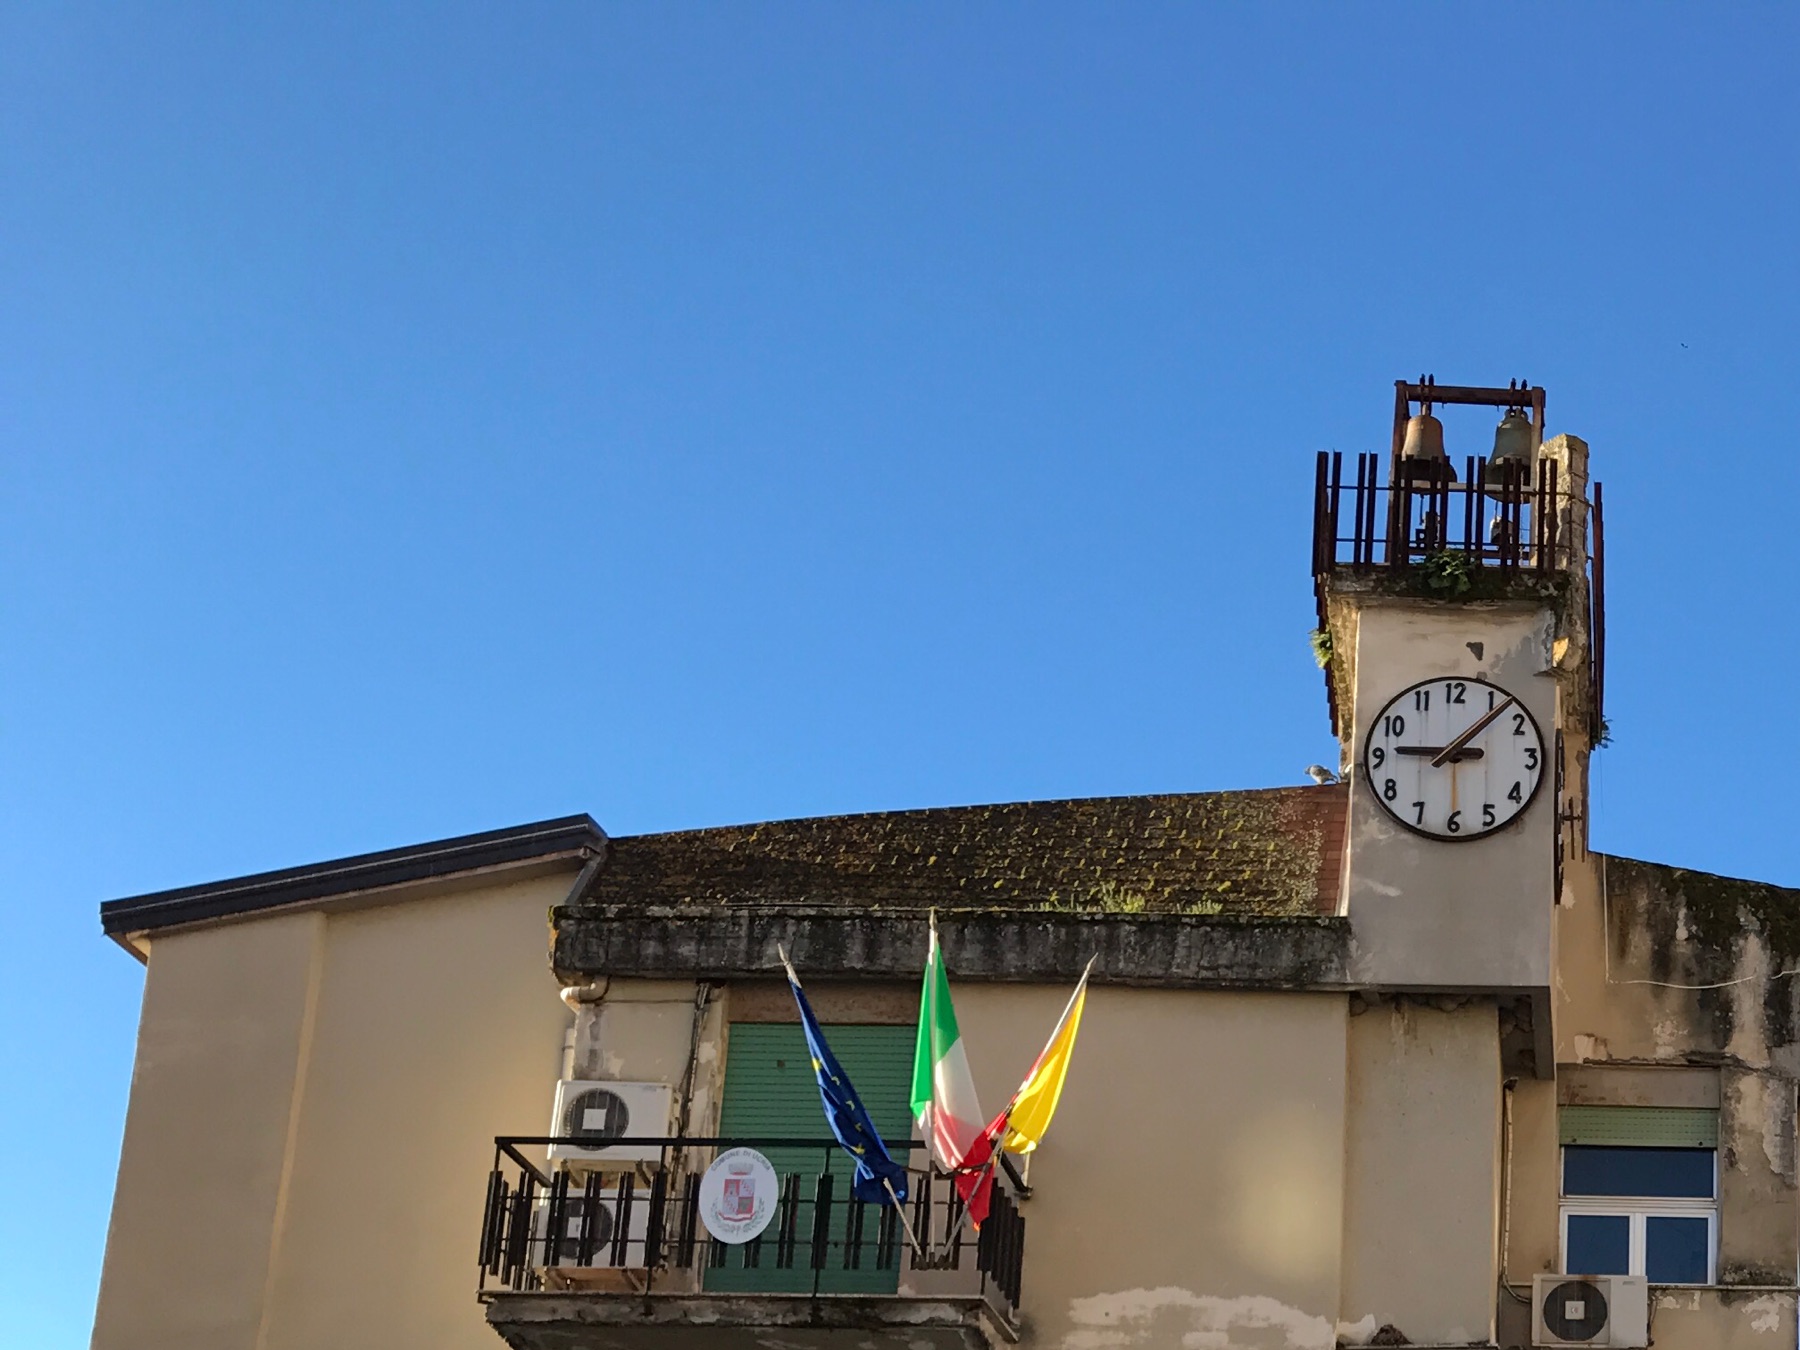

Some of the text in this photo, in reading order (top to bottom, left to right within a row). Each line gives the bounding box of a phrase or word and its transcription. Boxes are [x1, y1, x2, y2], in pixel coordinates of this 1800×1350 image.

[1414, 690, 1430, 711] 11
[1445, 682, 1467, 704] 12
[1487, 691, 1495, 712] 1
[1384, 715, 1405, 737] 10
[1512, 713, 1525, 736] 2
[1372, 747, 1385, 770] 9
[1524, 748, 1538, 771] 3
[1383, 778, 1397, 801] 8
[1507, 781, 1521, 804] 4
[1412, 801, 1425, 825] 7
[1447, 811, 1462, 833] 6
[1483, 804, 1496, 827] 5
[710, 1150, 740, 1172] COMUNE
